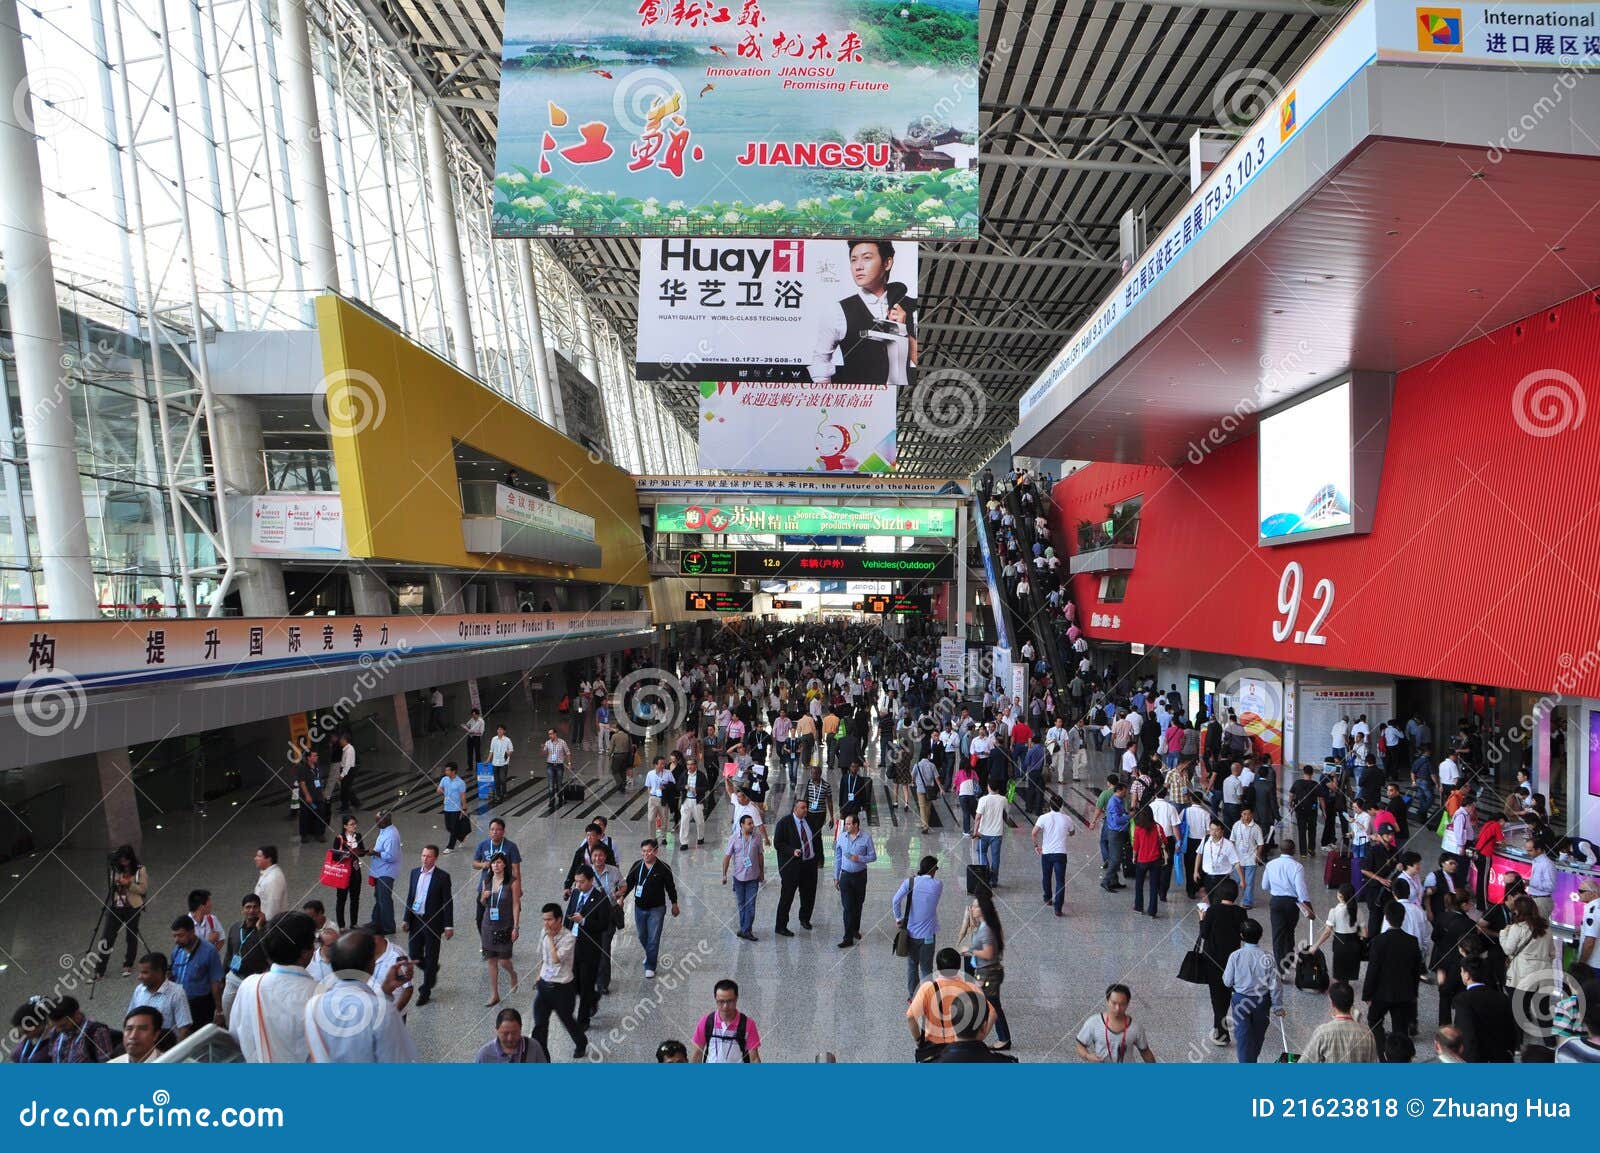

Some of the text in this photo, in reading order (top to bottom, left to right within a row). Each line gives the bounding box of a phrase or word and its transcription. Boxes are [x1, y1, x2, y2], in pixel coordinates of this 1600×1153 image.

[1484, 9, 1595, 27] International
[1486, 32, 1600, 56] 进口展区设
[706, 66, 836, 78] Innovation JIANGSU
[783, 79, 889, 93] Promising Future
[737, 143, 890, 167] JIANGSU
[659, 278, 804, 310] 华艺卫浴
[741, 393, 873, 408] 欢迎选购宁波优质商品
[763, 558, 781, 567] 12.0
[862, 559, 935, 571] Vehicles(Outdoor)
[1272, 561, 1335, 645] 9.2
[458, 620, 490, 639] Optimize
[496, 620, 517, 635] Export
[522, 619, 543, 633] Product
[29, 622, 389, 672] 构 提升国际竞争力
